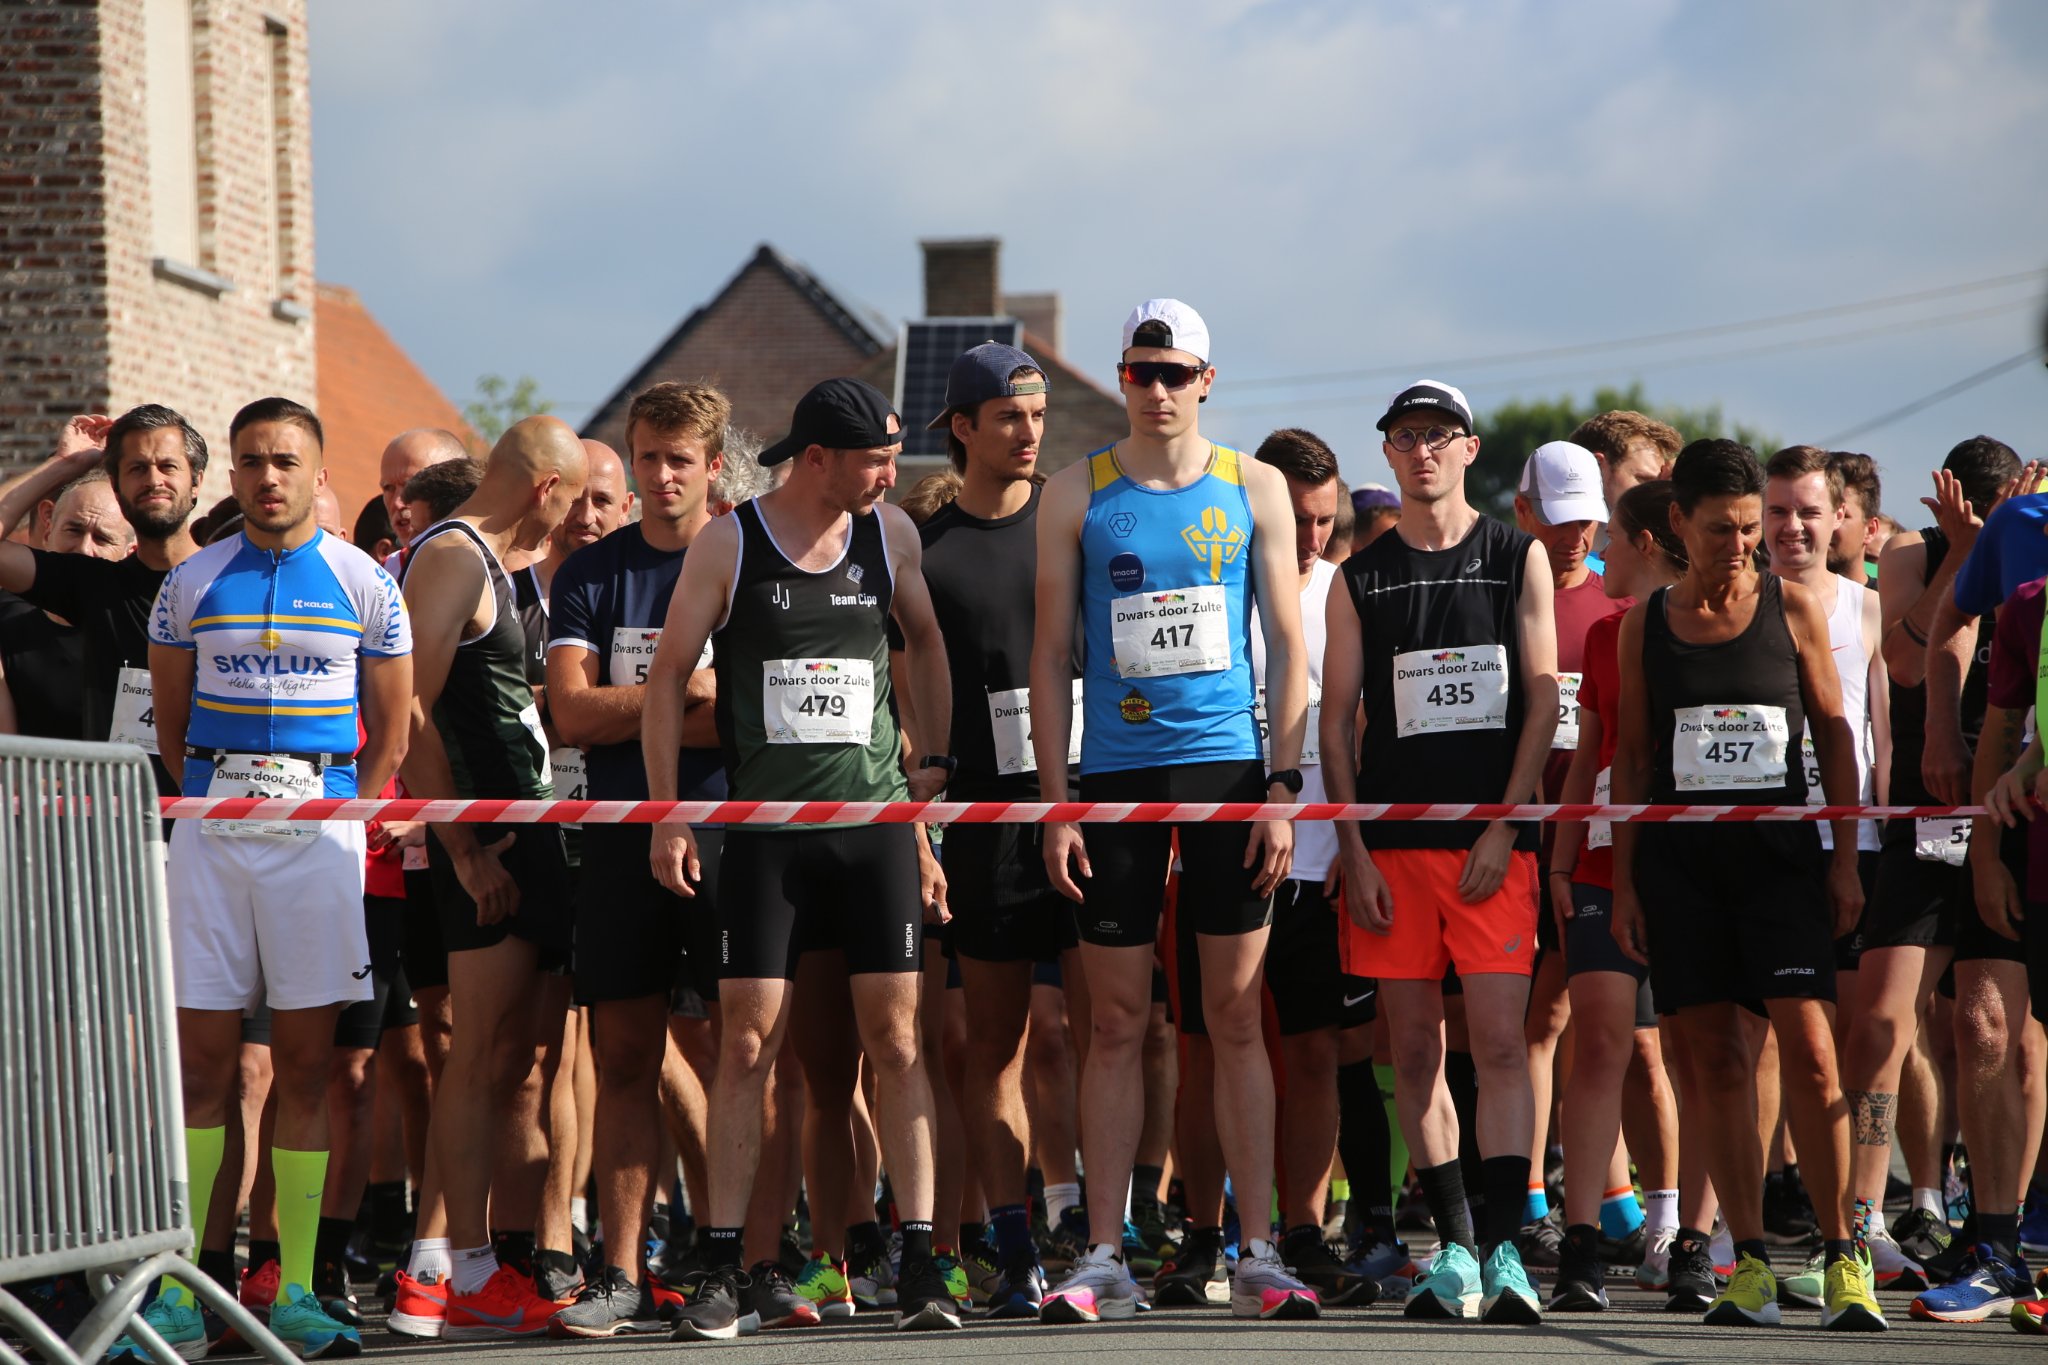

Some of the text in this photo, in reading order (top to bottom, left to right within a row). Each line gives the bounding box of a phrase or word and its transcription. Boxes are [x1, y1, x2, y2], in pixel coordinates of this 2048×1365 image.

[829, 592, 877, 608] Team Cipo
[1117, 601, 1222, 622] Dwars door Zulte
[1150, 624, 1194, 650] 417
[614, 643, 642, 654] Dwars
[213, 654, 332, 675] SKYLUX
[1397, 661, 1502, 680] Dwars door Zulte
[122, 683, 153, 697] Dwars
[227, 676, 255, 689] Hello
[769, 674, 870, 687] Dwars door Zulte
[1426, 682, 1475, 706] 435
[798, 695, 846, 717] 479
[995, 705, 1030, 718] Dwars
[1680, 721, 1784, 732] Dwars door Zulte
[1705, 741, 1755, 763] 457
[216, 769, 319, 789] Dwars door Zulte
[905, 923, 913, 958] FUSION
[1774, 967, 1815, 976] JARTAZI
